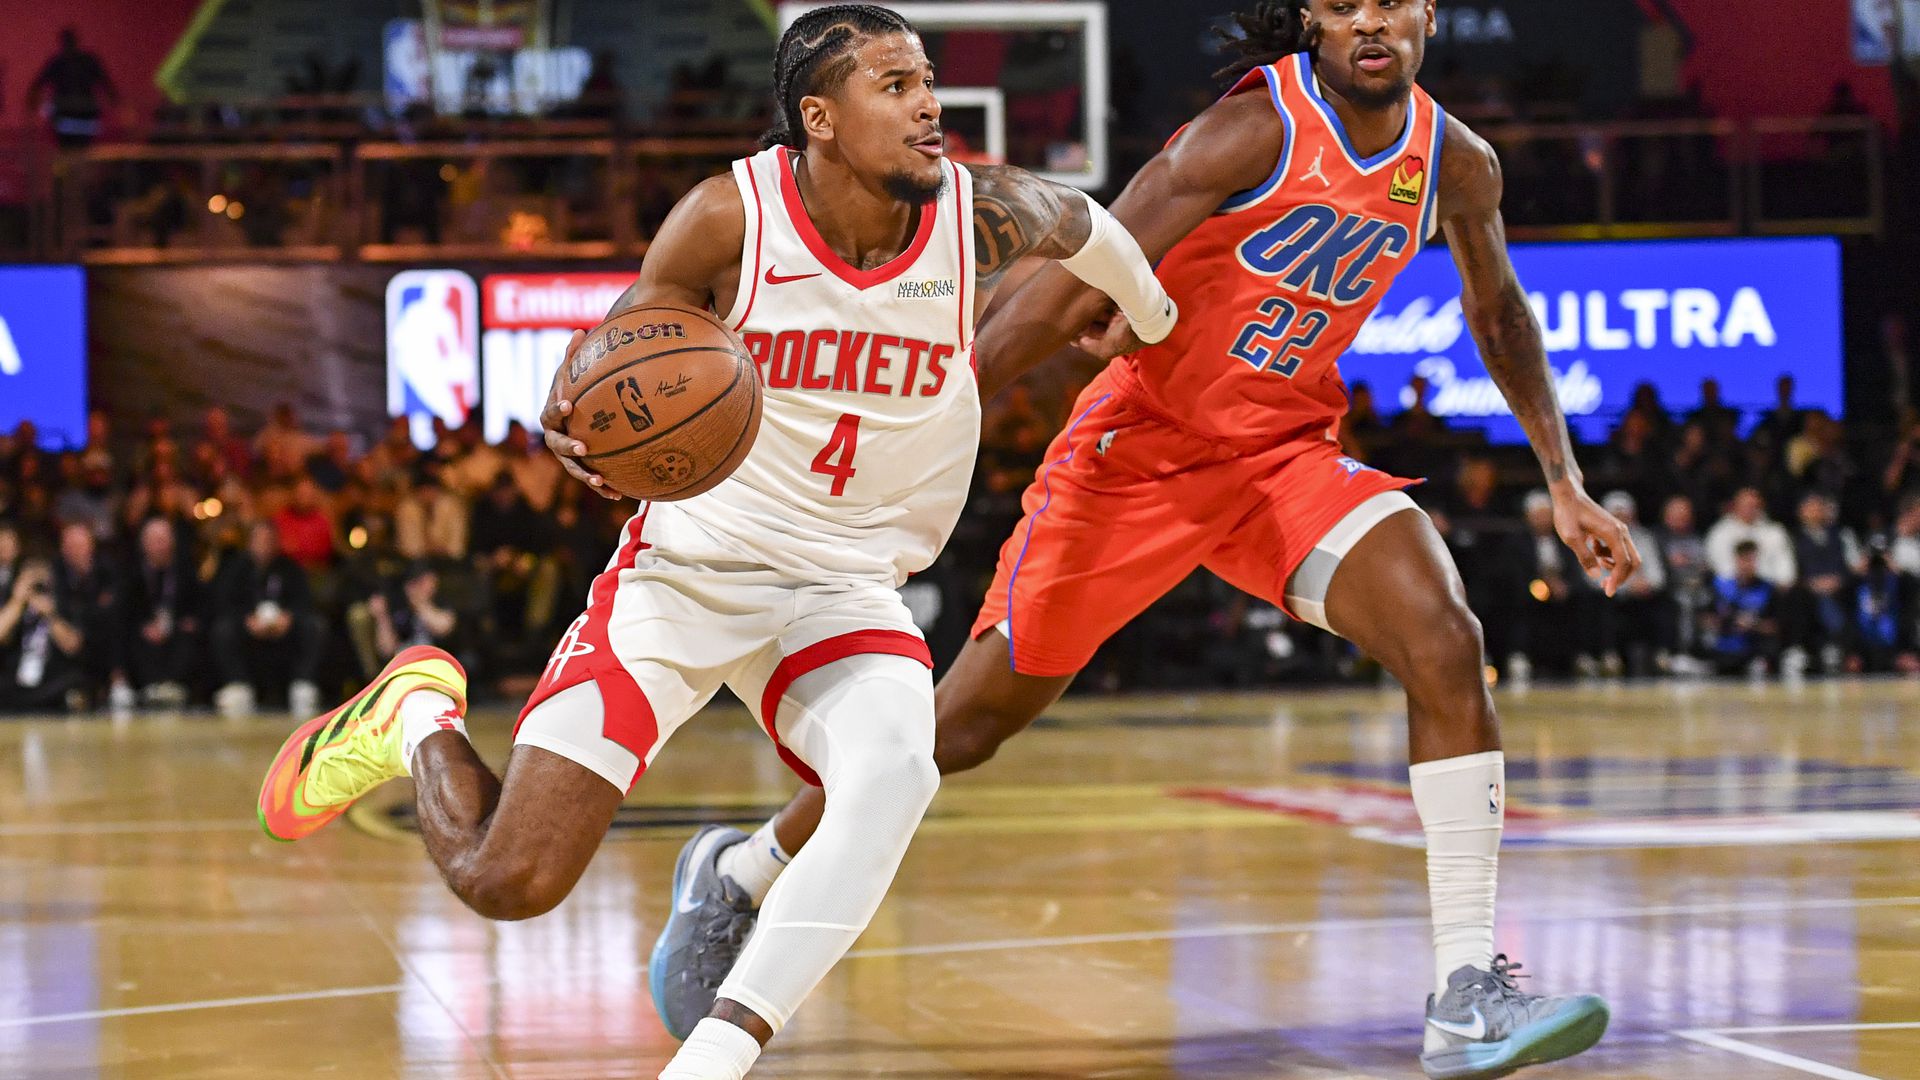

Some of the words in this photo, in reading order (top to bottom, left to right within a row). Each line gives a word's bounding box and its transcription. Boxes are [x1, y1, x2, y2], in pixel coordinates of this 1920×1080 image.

[897, 279, 955, 293] MEMORIAL
[1235, 203, 1410, 307] OKC
[897, 286, 954, 298] HERMANN
[1529, 286, 1776, 352] ULTRA
[568, 321, 688, 384] Wilson
[742, 329, 956, 398] ROCKETS
[1227, 296, 1331, 380] 22
[810, 413, 862, 497] 4
